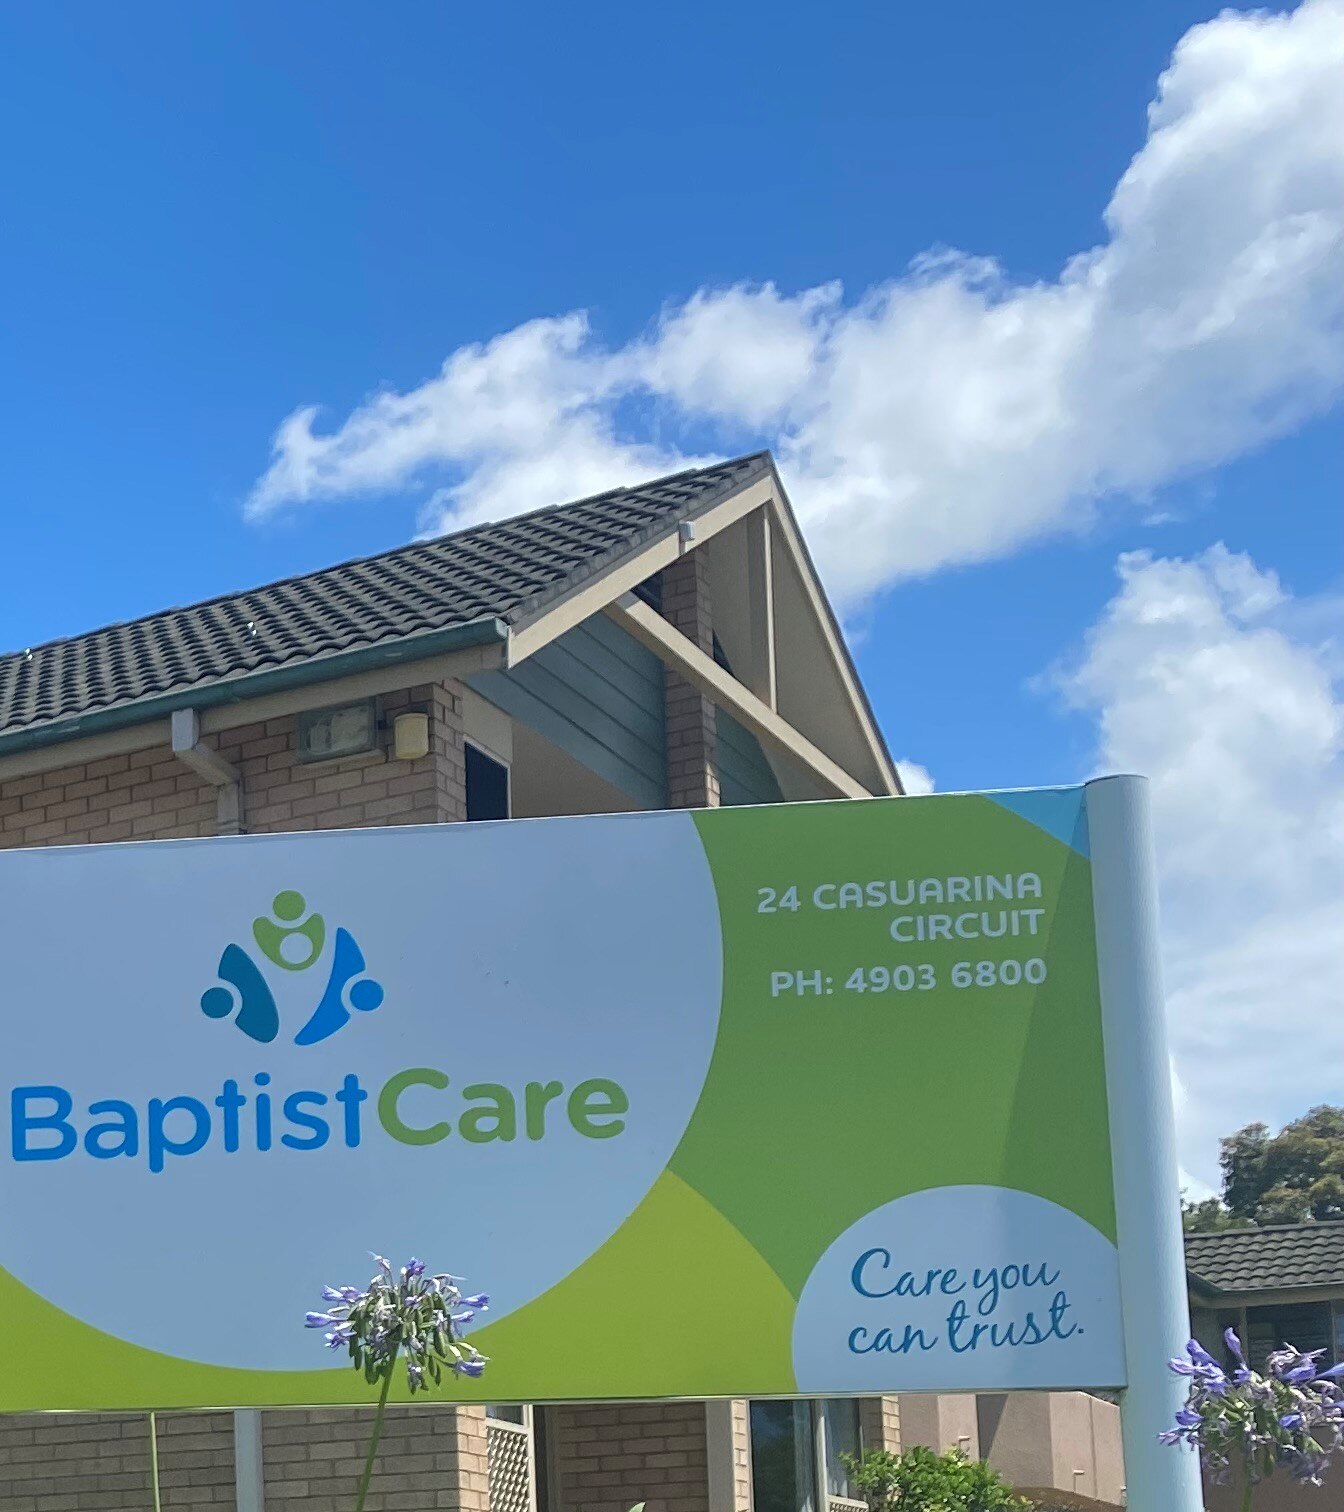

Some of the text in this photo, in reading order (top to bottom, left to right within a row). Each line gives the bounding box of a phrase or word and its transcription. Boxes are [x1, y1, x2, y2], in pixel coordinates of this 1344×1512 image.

[757, 872, 1042, 913] 24 CASUARINA
[890, 908, 1045, 943] CIRCUIT
[771, 957, 1048, 997] PH: 4903 6800
[11, 1068, 629, 1174] BaptistCare
[851, 1247, 1060, 1316] Care you
[848, 1290, 1084, 1354] can trust.
